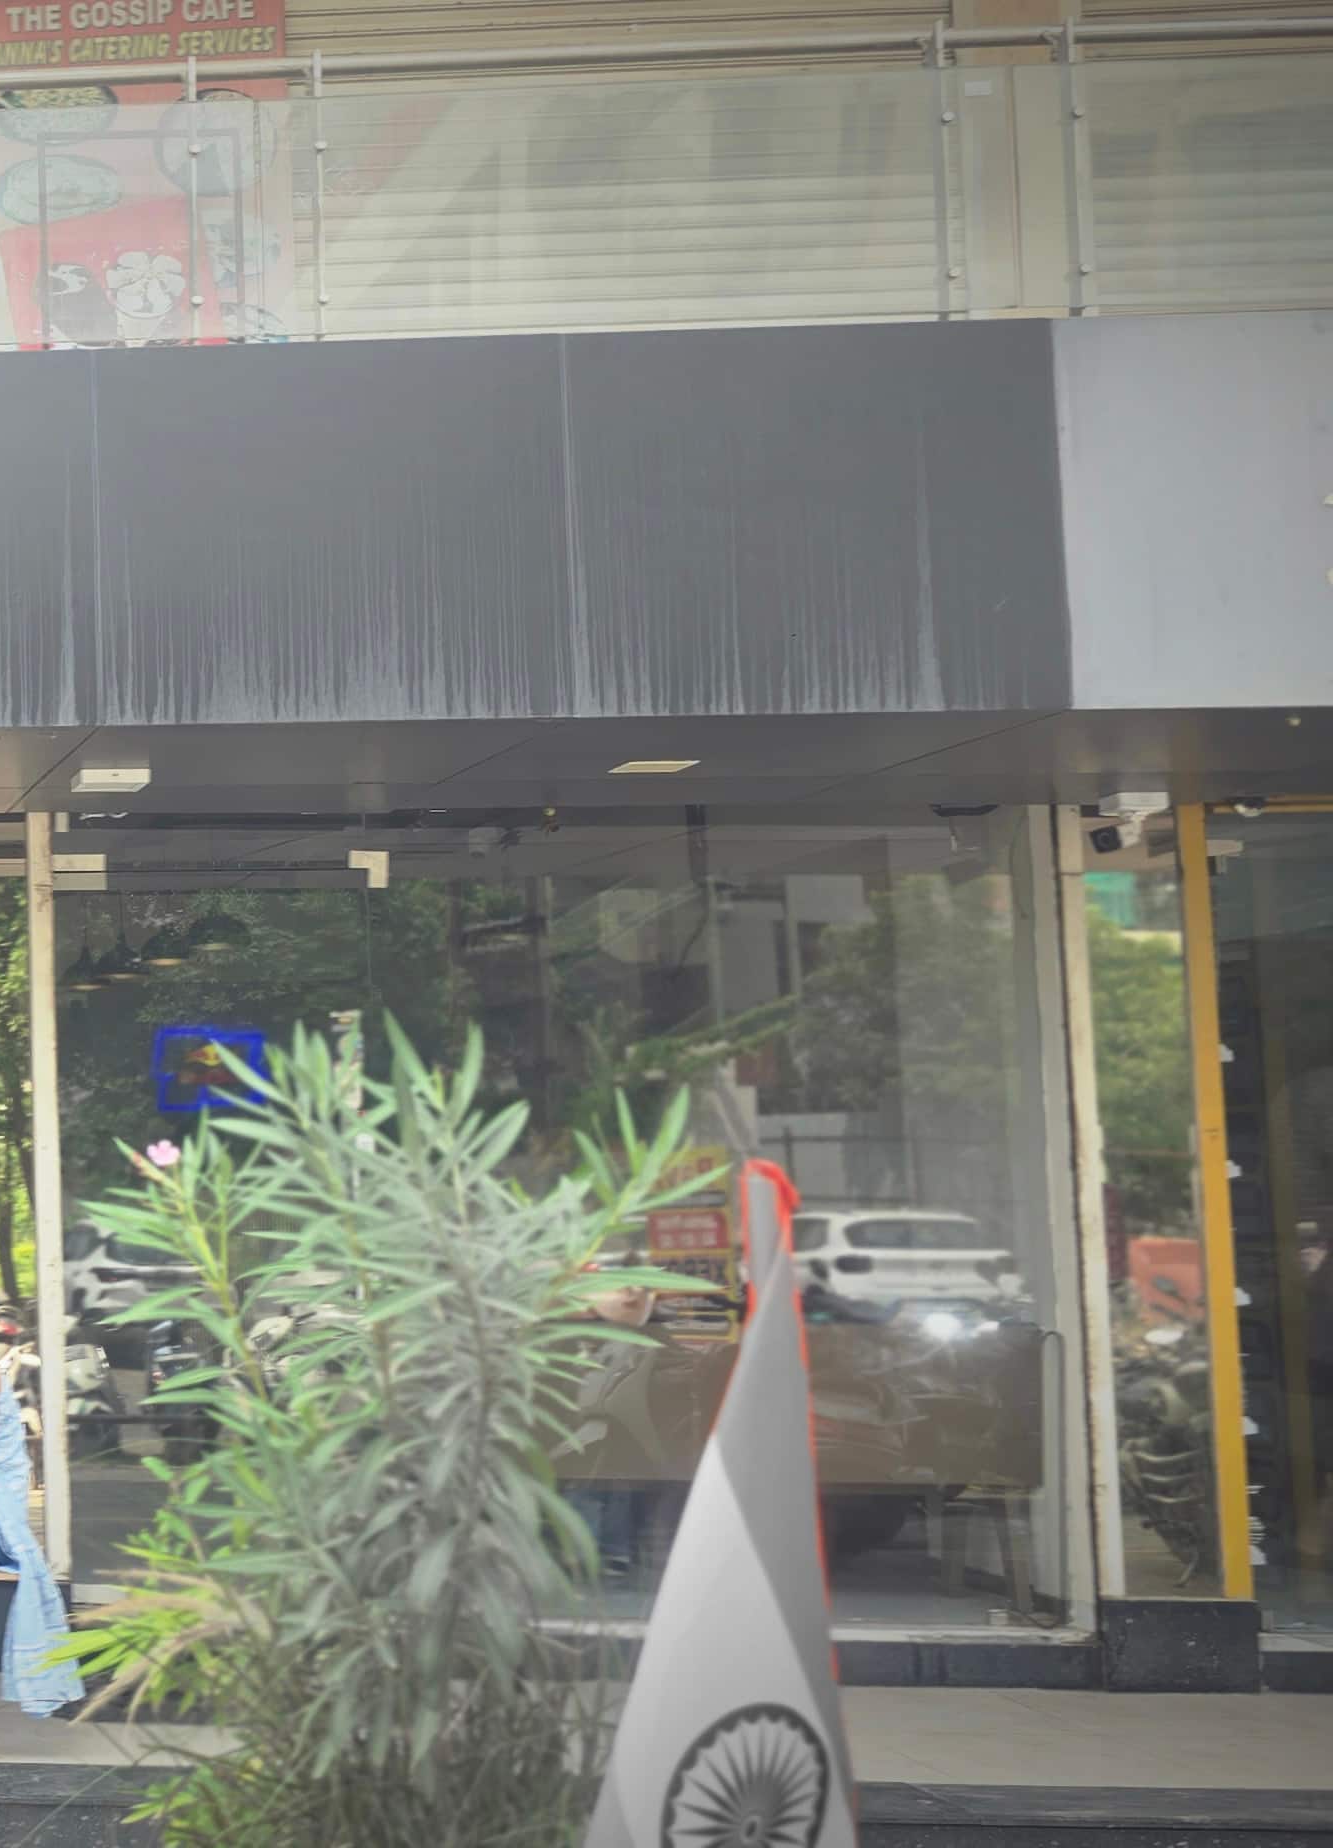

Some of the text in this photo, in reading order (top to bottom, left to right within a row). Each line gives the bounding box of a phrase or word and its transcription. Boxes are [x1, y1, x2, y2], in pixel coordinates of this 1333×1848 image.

[6, 0, 255, 32] THE GOSSIP CAFE
[68, 33, 172, 62] CATERING
[176, 26, 277, 56] SERVICES
